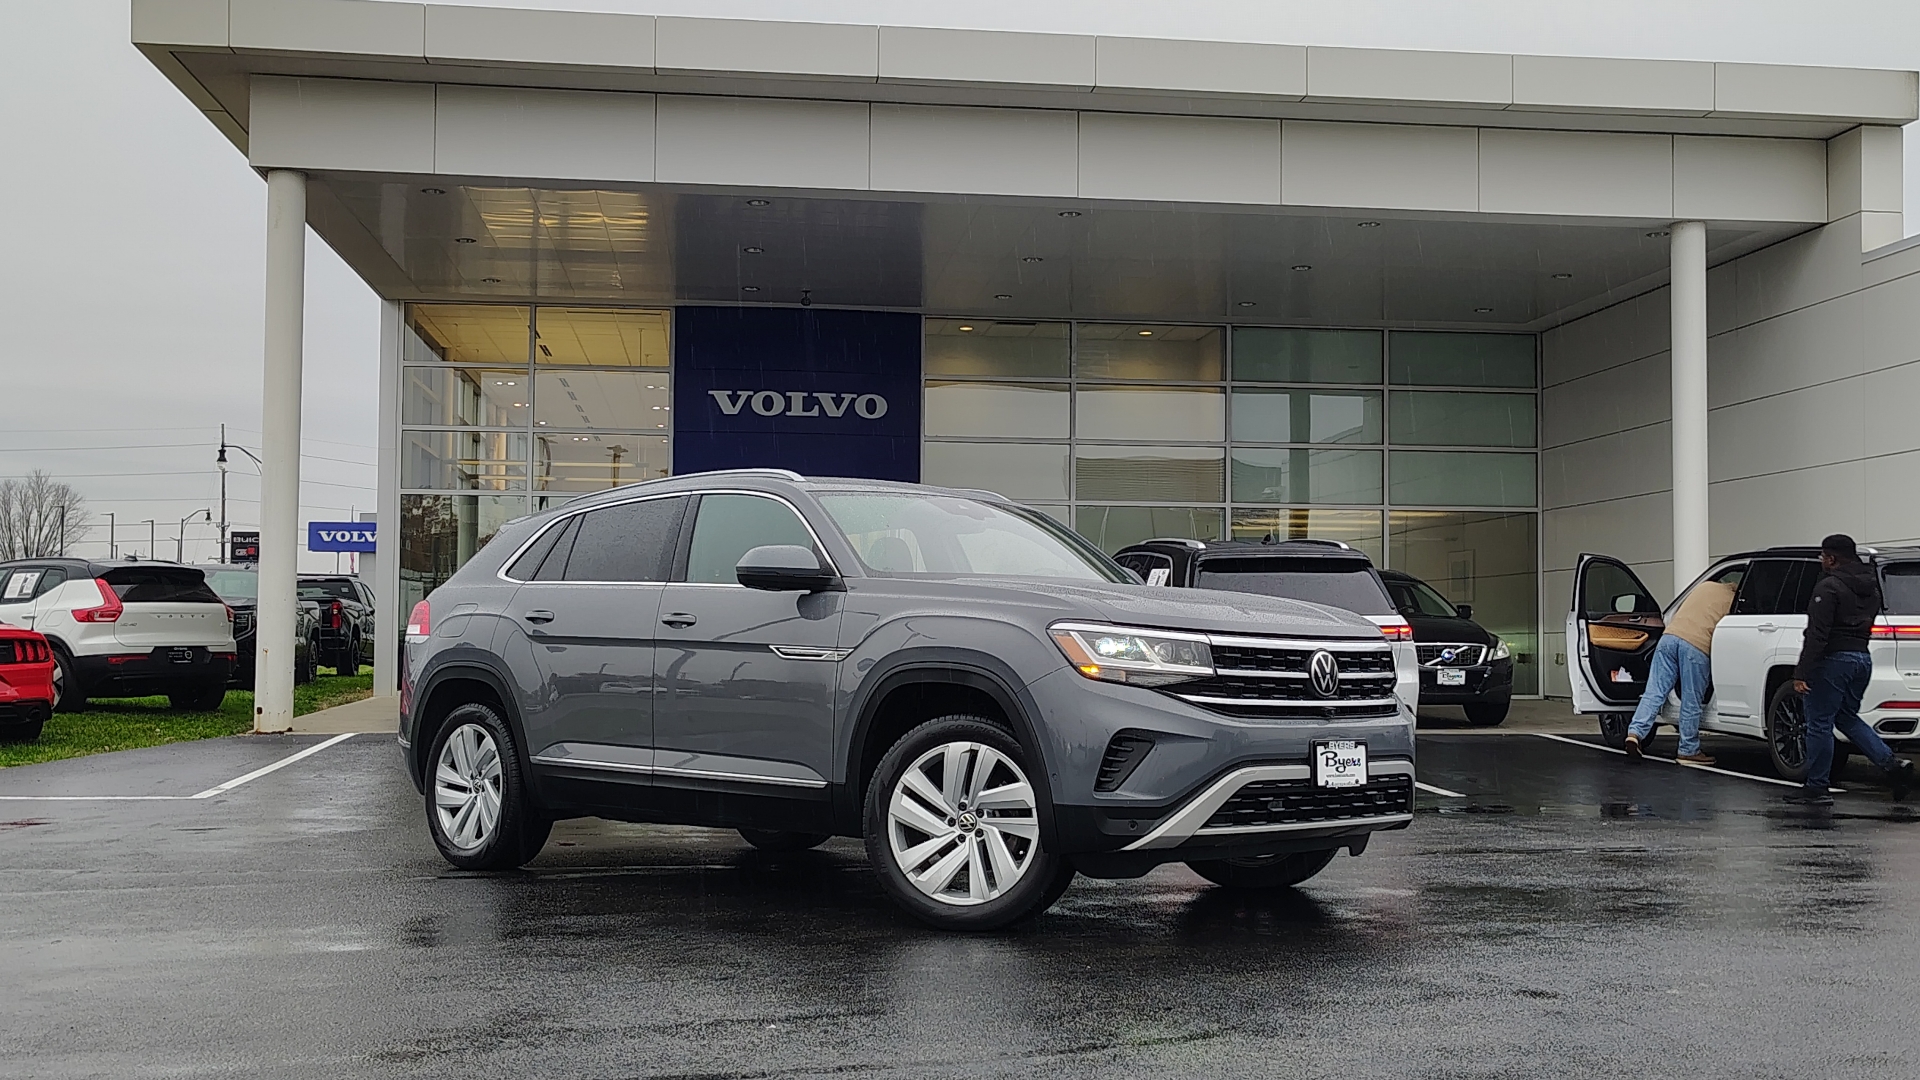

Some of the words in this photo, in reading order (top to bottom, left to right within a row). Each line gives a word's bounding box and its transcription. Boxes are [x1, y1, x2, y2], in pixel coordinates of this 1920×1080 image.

[708, 390, 888, 419] VOLVO
[317, 530, 377, 543] VOLV
[1329, 740, 1356, 750] BYERS
[1320, 750, 1361, 774] Byers
